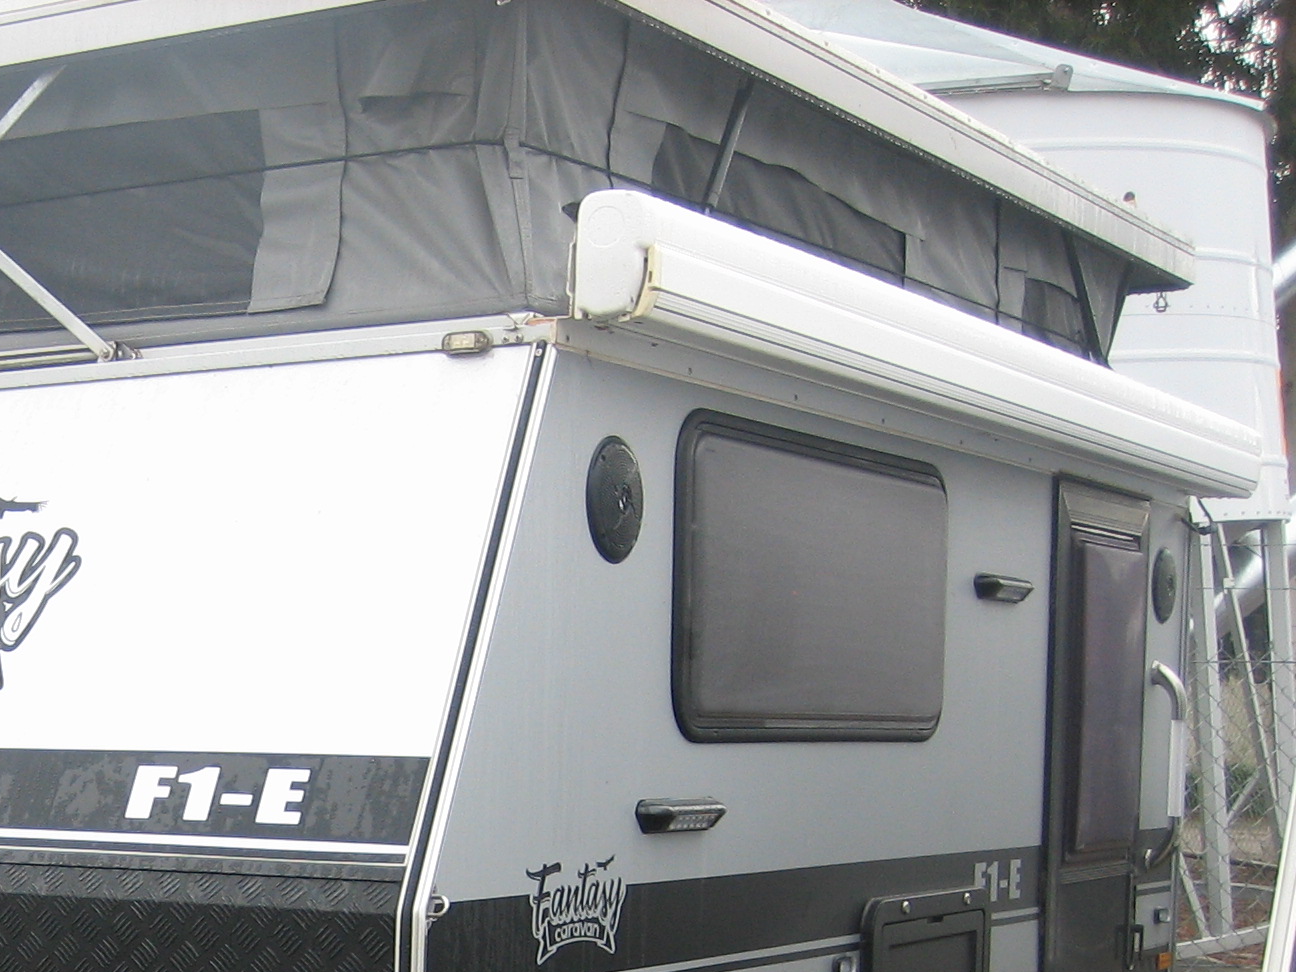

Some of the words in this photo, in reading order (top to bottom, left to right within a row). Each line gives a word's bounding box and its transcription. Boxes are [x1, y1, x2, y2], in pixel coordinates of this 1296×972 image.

[124, 764, 312, 826] F1-E
[525, 863, 626, 938] Fantasy
[974, 859, 1021, 902] F1-E
[554, 921, 600, 942] caravan
